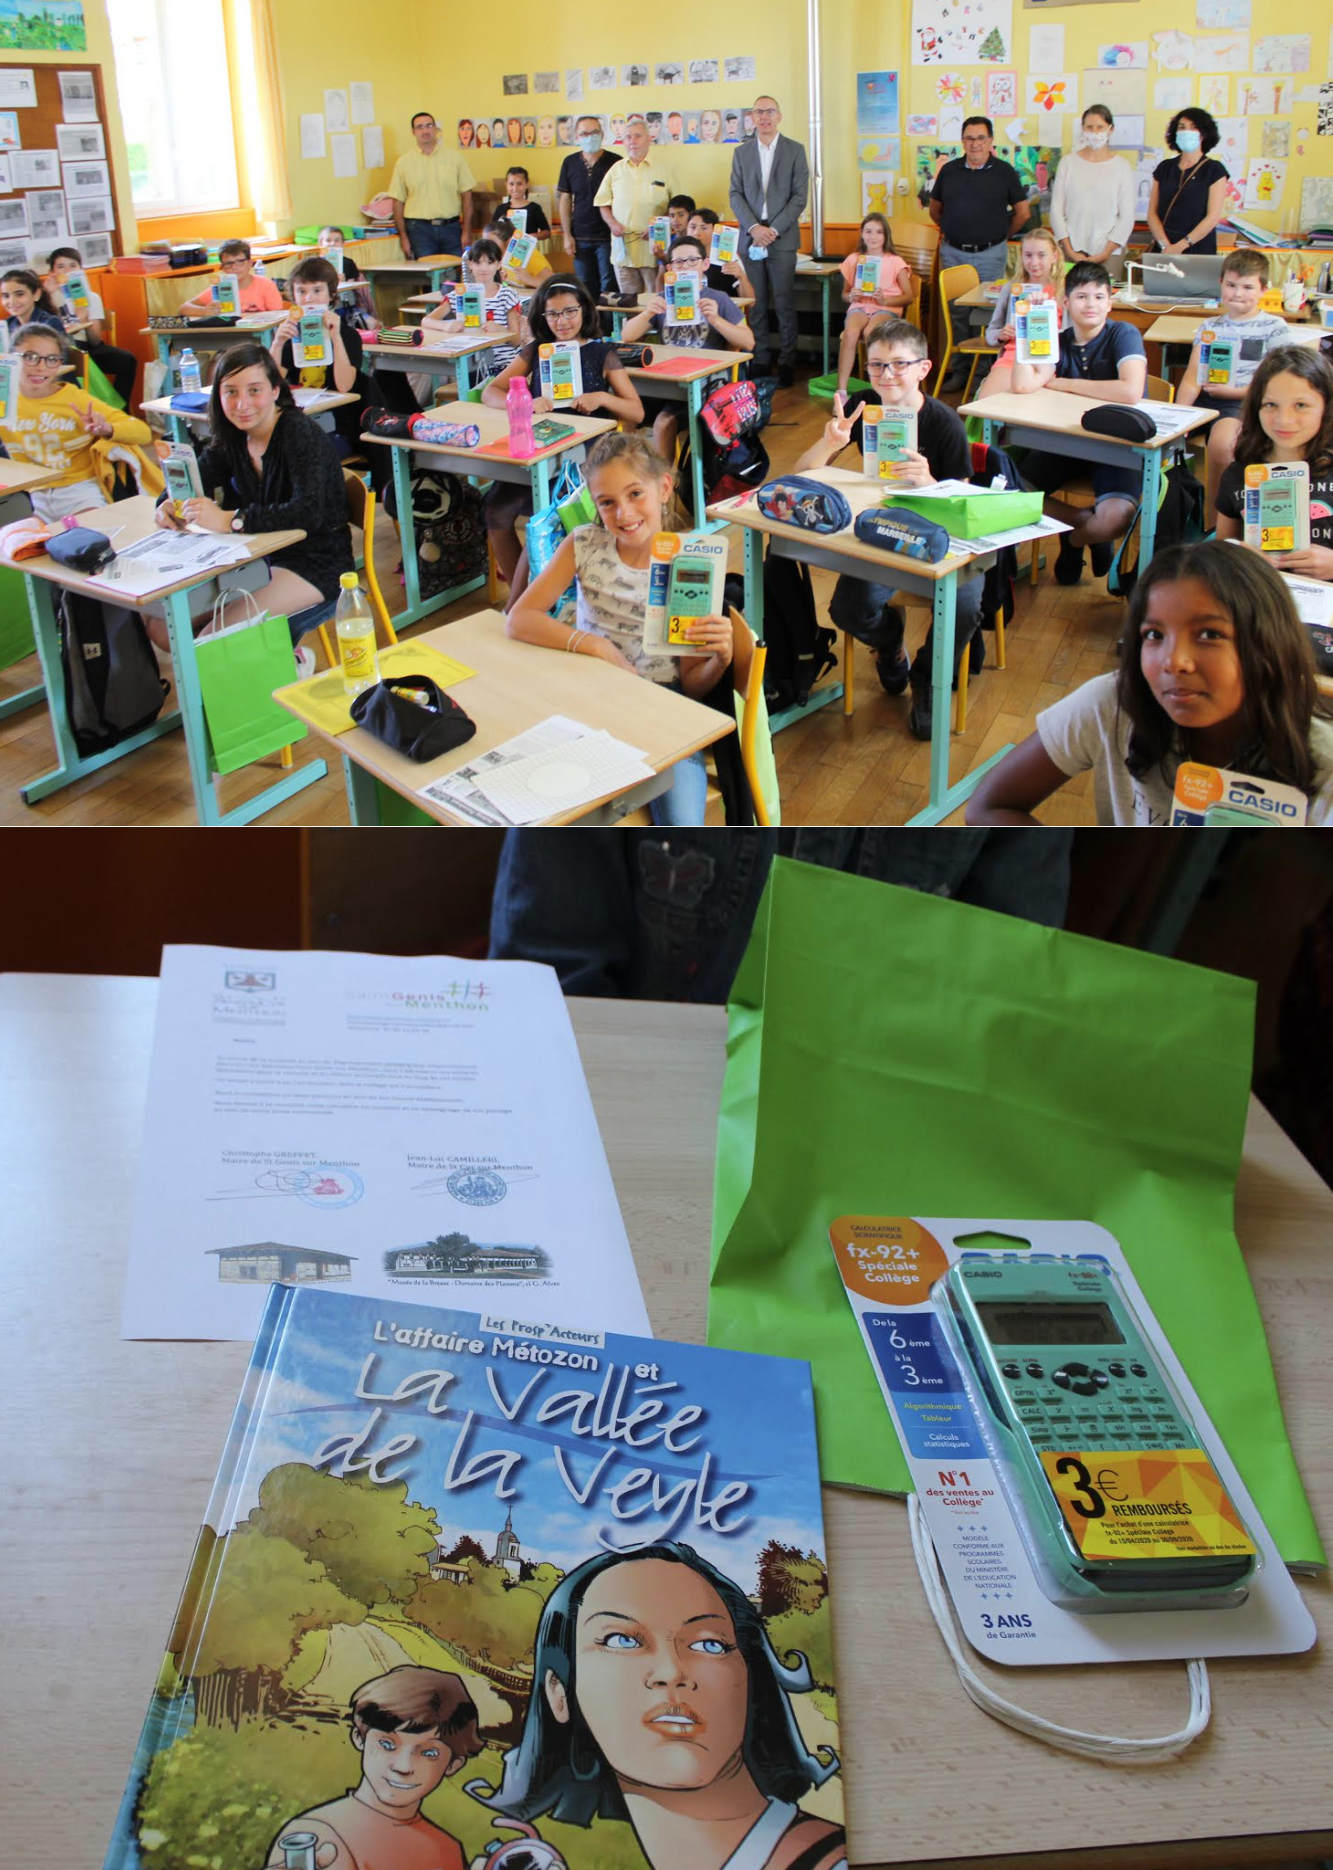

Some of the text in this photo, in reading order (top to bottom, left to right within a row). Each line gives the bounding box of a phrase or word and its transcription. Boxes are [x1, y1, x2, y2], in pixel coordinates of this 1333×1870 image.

[1271, 469, 1305, 479] CASIO
[1262, 529, 1269, 542] 3
[683, 544, 723, 554] CASIO
[671, 617, 680, 633] 3
[1228, 790, 1297, 817] CASIO
[405, 1000, 489, 1011] Menthon
[846, 1243, 920, 1259] fx-92+
[857, 1260, 918, 1272] Spéciale
[864, 1272, 920, 1285] Collège
[486, 1316, 505, 1331] Les
[373, 1320, 600, 1371] L'affaire Métozon
[889, 1329, 907, 1349] 6
[634, 1362, 660, 1382] et
[900, 1365, 920, 1385] 3
[354, 1352, 703, 1452] La Vallée
[921, 1414, 952, 1422] Tableur
[928, 1433, 959, 1441] Calculs
[312, 1407, 749, 1554] de la Veyle
[926, 1488, 944, 1497] des
[946, 1489, 979, 1497] ventes
[1112, 1501, 1193, 1517] REMBOURSÉS
[980, 1613, 1033, 1628] 3 ANS
[986, 1630, 1037, 1639] de Garantie
